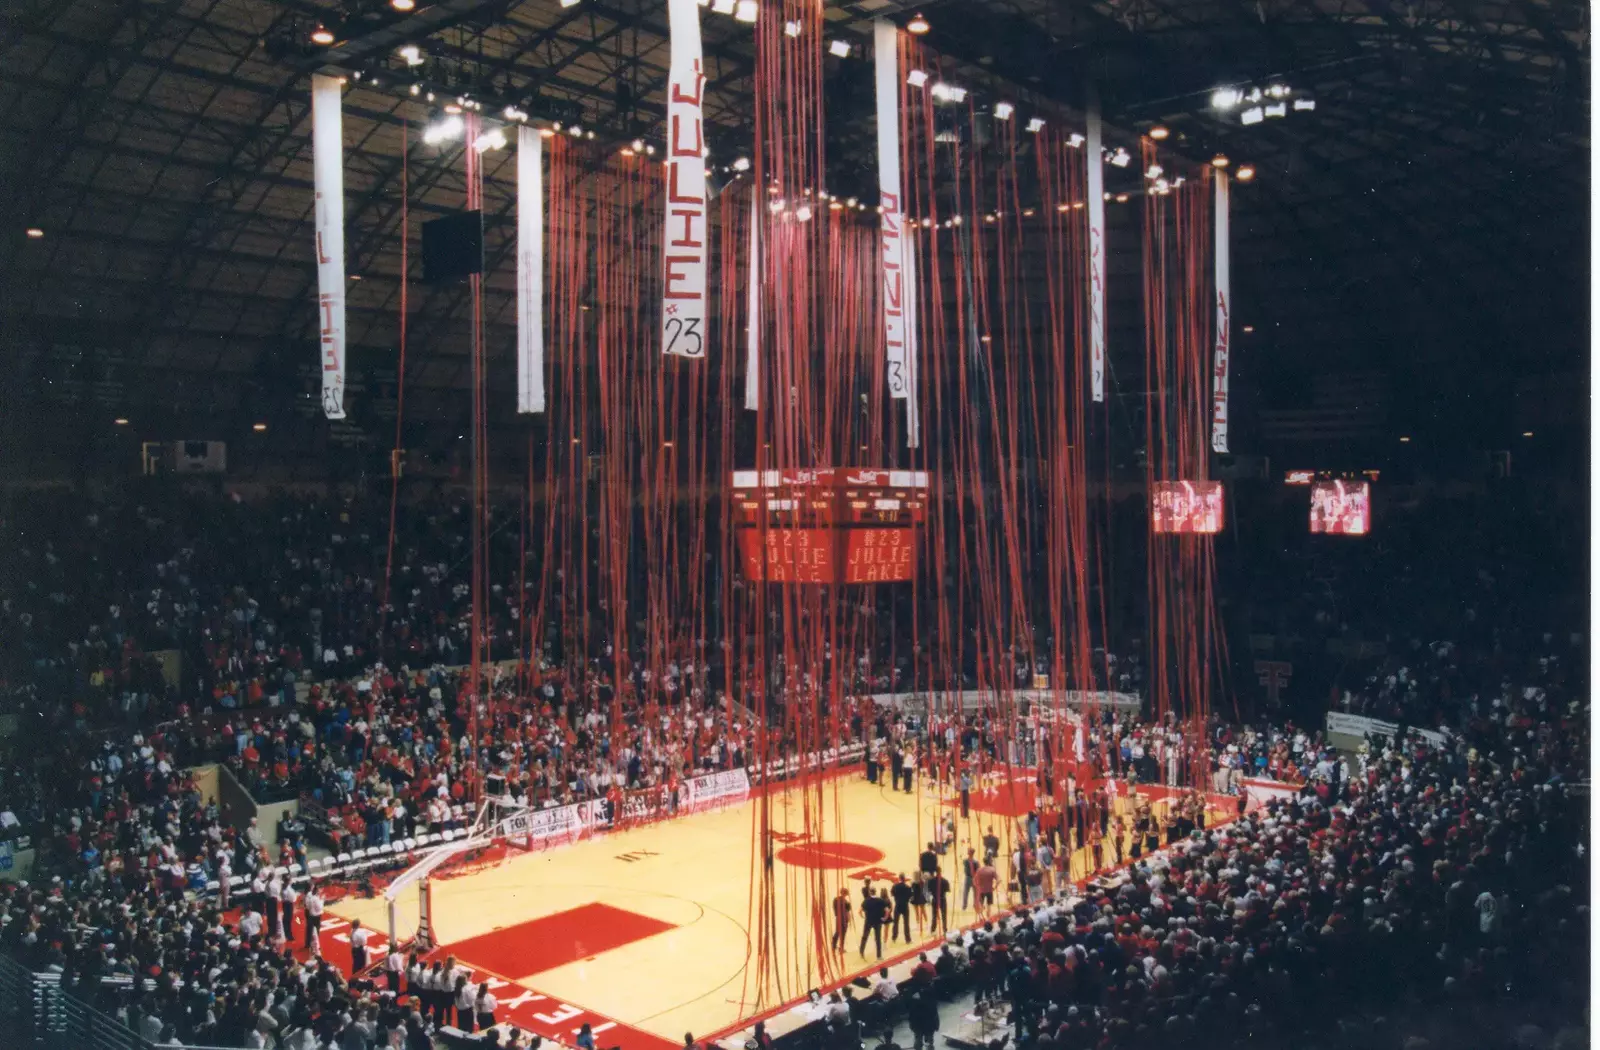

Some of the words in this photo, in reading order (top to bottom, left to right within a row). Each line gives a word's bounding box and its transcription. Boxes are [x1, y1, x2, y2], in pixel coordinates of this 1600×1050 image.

[664, 57, 704, 300] JULIE
[767, 529, 808, 547] #23
[864, 529, 901, 547] #23
[849, 547, 911, 565] JULIE
[854, 563, 904, 582] LAKE
[509, 815, 526, 831] FOX
